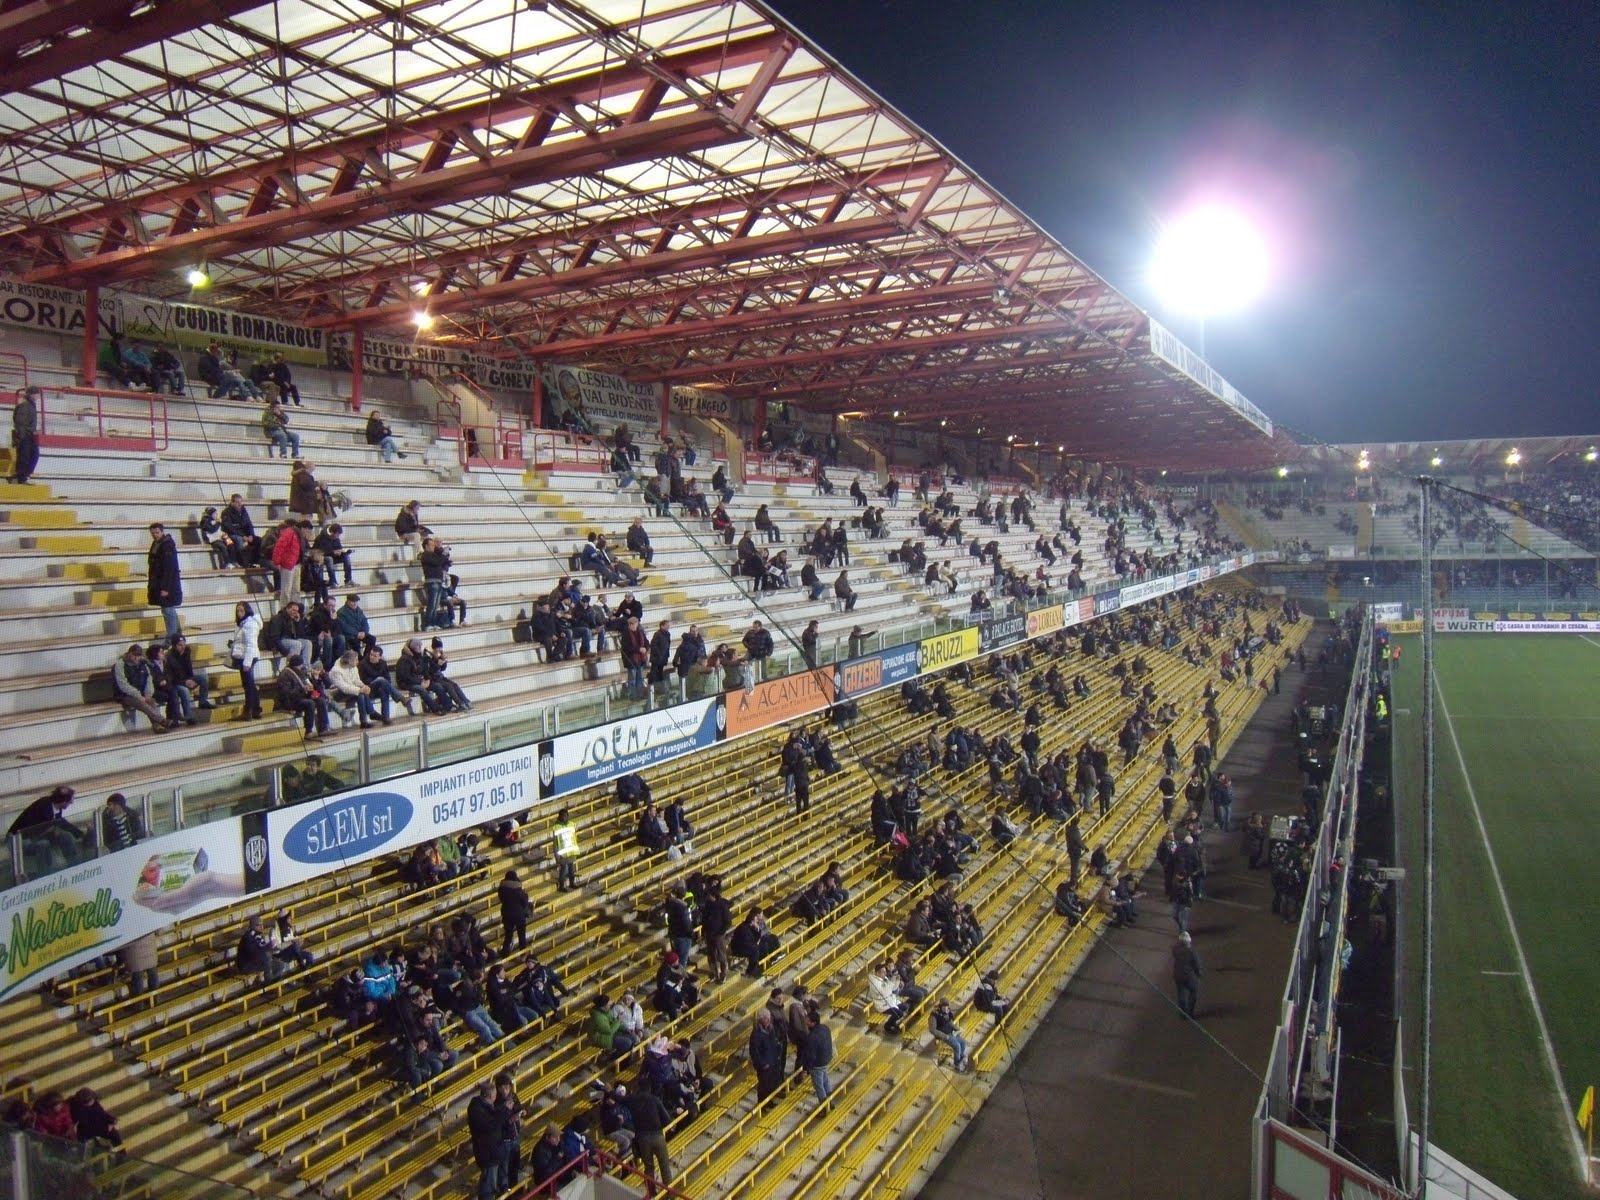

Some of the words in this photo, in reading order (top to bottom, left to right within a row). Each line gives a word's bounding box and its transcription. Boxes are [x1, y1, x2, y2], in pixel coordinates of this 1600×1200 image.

[18, 284, 73, 304] RISTORANTE
[76, 295, 115, 312] ALGO
[0, 298, 117, 338] ORIAN
[174, 305, 229, 335] CUORE
[232, 314, 322, 350] ROMAGNOLO
[417, 347, 446, 361] CLUB
[578, 371, 624, 392] CESENA
[583, 389, 607, 404] VAL
[609, 392, 656, 412] BIDENTE
[586, 406, 618, 419] CIVITELLA
[1415, 609, 1465, 617] WMPUM
[1448, 621, 1493, 630] WÜRTH
[921, 635, 963, 668] BARUZZI
[581, 724, 653, 766] SOEMS
[656, 715, 698, 735] www.soems.it
[421, 774, 466, 799] IMPIANTI
[469, 756, 532, 785] FOTOVOLTAICI
[587, 761, 614, 779] Impianti
[618, 750, 652, 770] Tecnologici
[433, 797, 466, 824] 0547
[470, 780, 523, 813] 97.05.01
[307, 805, 369, 856] SLEM
[372, 806, 394, 836] srl
[9, 887, 122, 975] Naturelle
